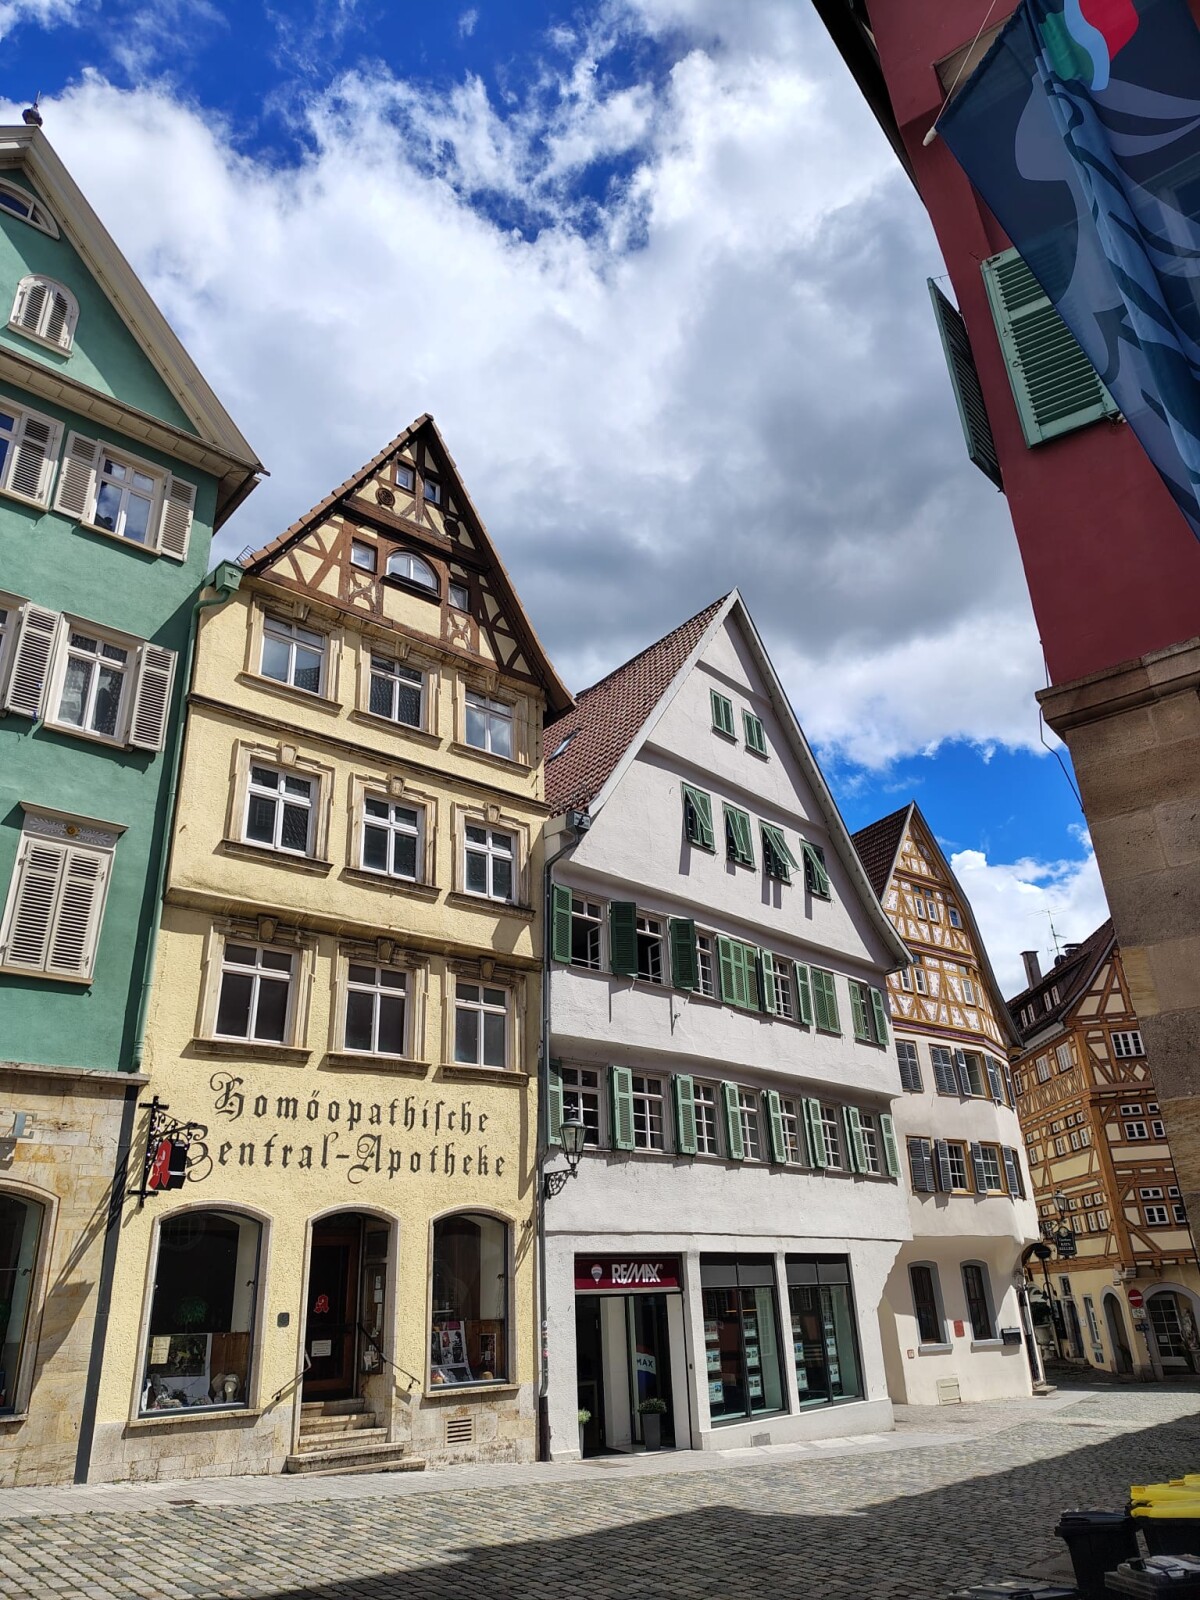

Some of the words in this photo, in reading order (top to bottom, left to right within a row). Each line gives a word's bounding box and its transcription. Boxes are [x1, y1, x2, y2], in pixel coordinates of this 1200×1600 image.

[210, 1072, 488, 1136] Homöopathische
[185, 1124, 505, 1184] Zentral-Apotheke
[611, 1263, 661, 1284] RE/MAX
